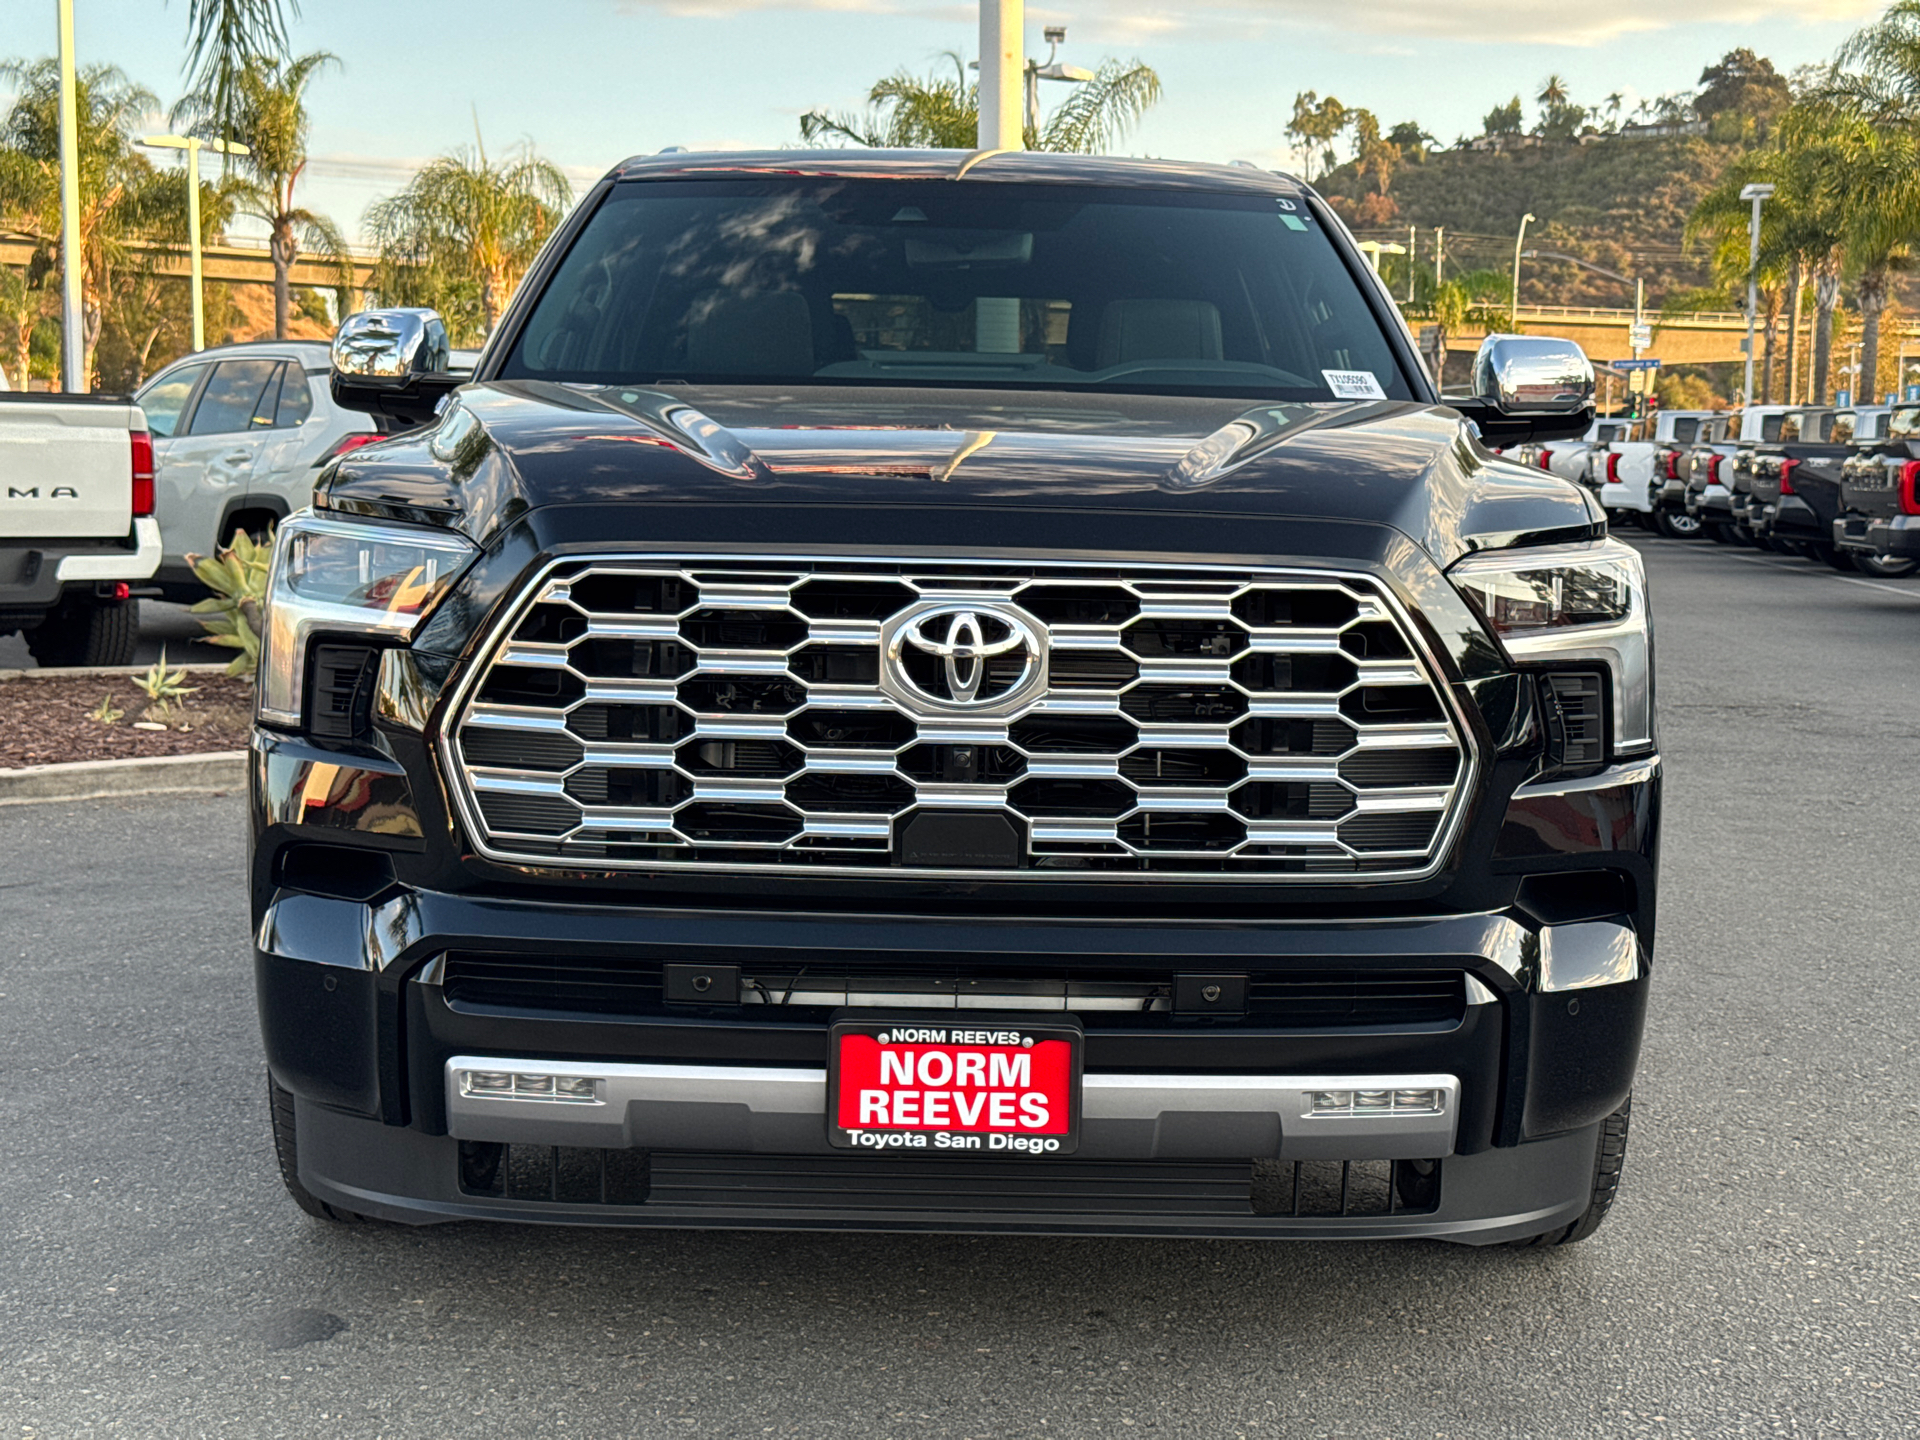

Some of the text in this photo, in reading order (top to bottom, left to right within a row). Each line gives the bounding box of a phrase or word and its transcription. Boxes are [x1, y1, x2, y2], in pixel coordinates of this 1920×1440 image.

[892, 1029, 1020, 1045] NORM REEVES
[880, 1050, 1031, 1087] NORM
[859, 1089, 1050, 1128] REEVES
[847, 1129, 1060, 1154] Toyota San Diego
